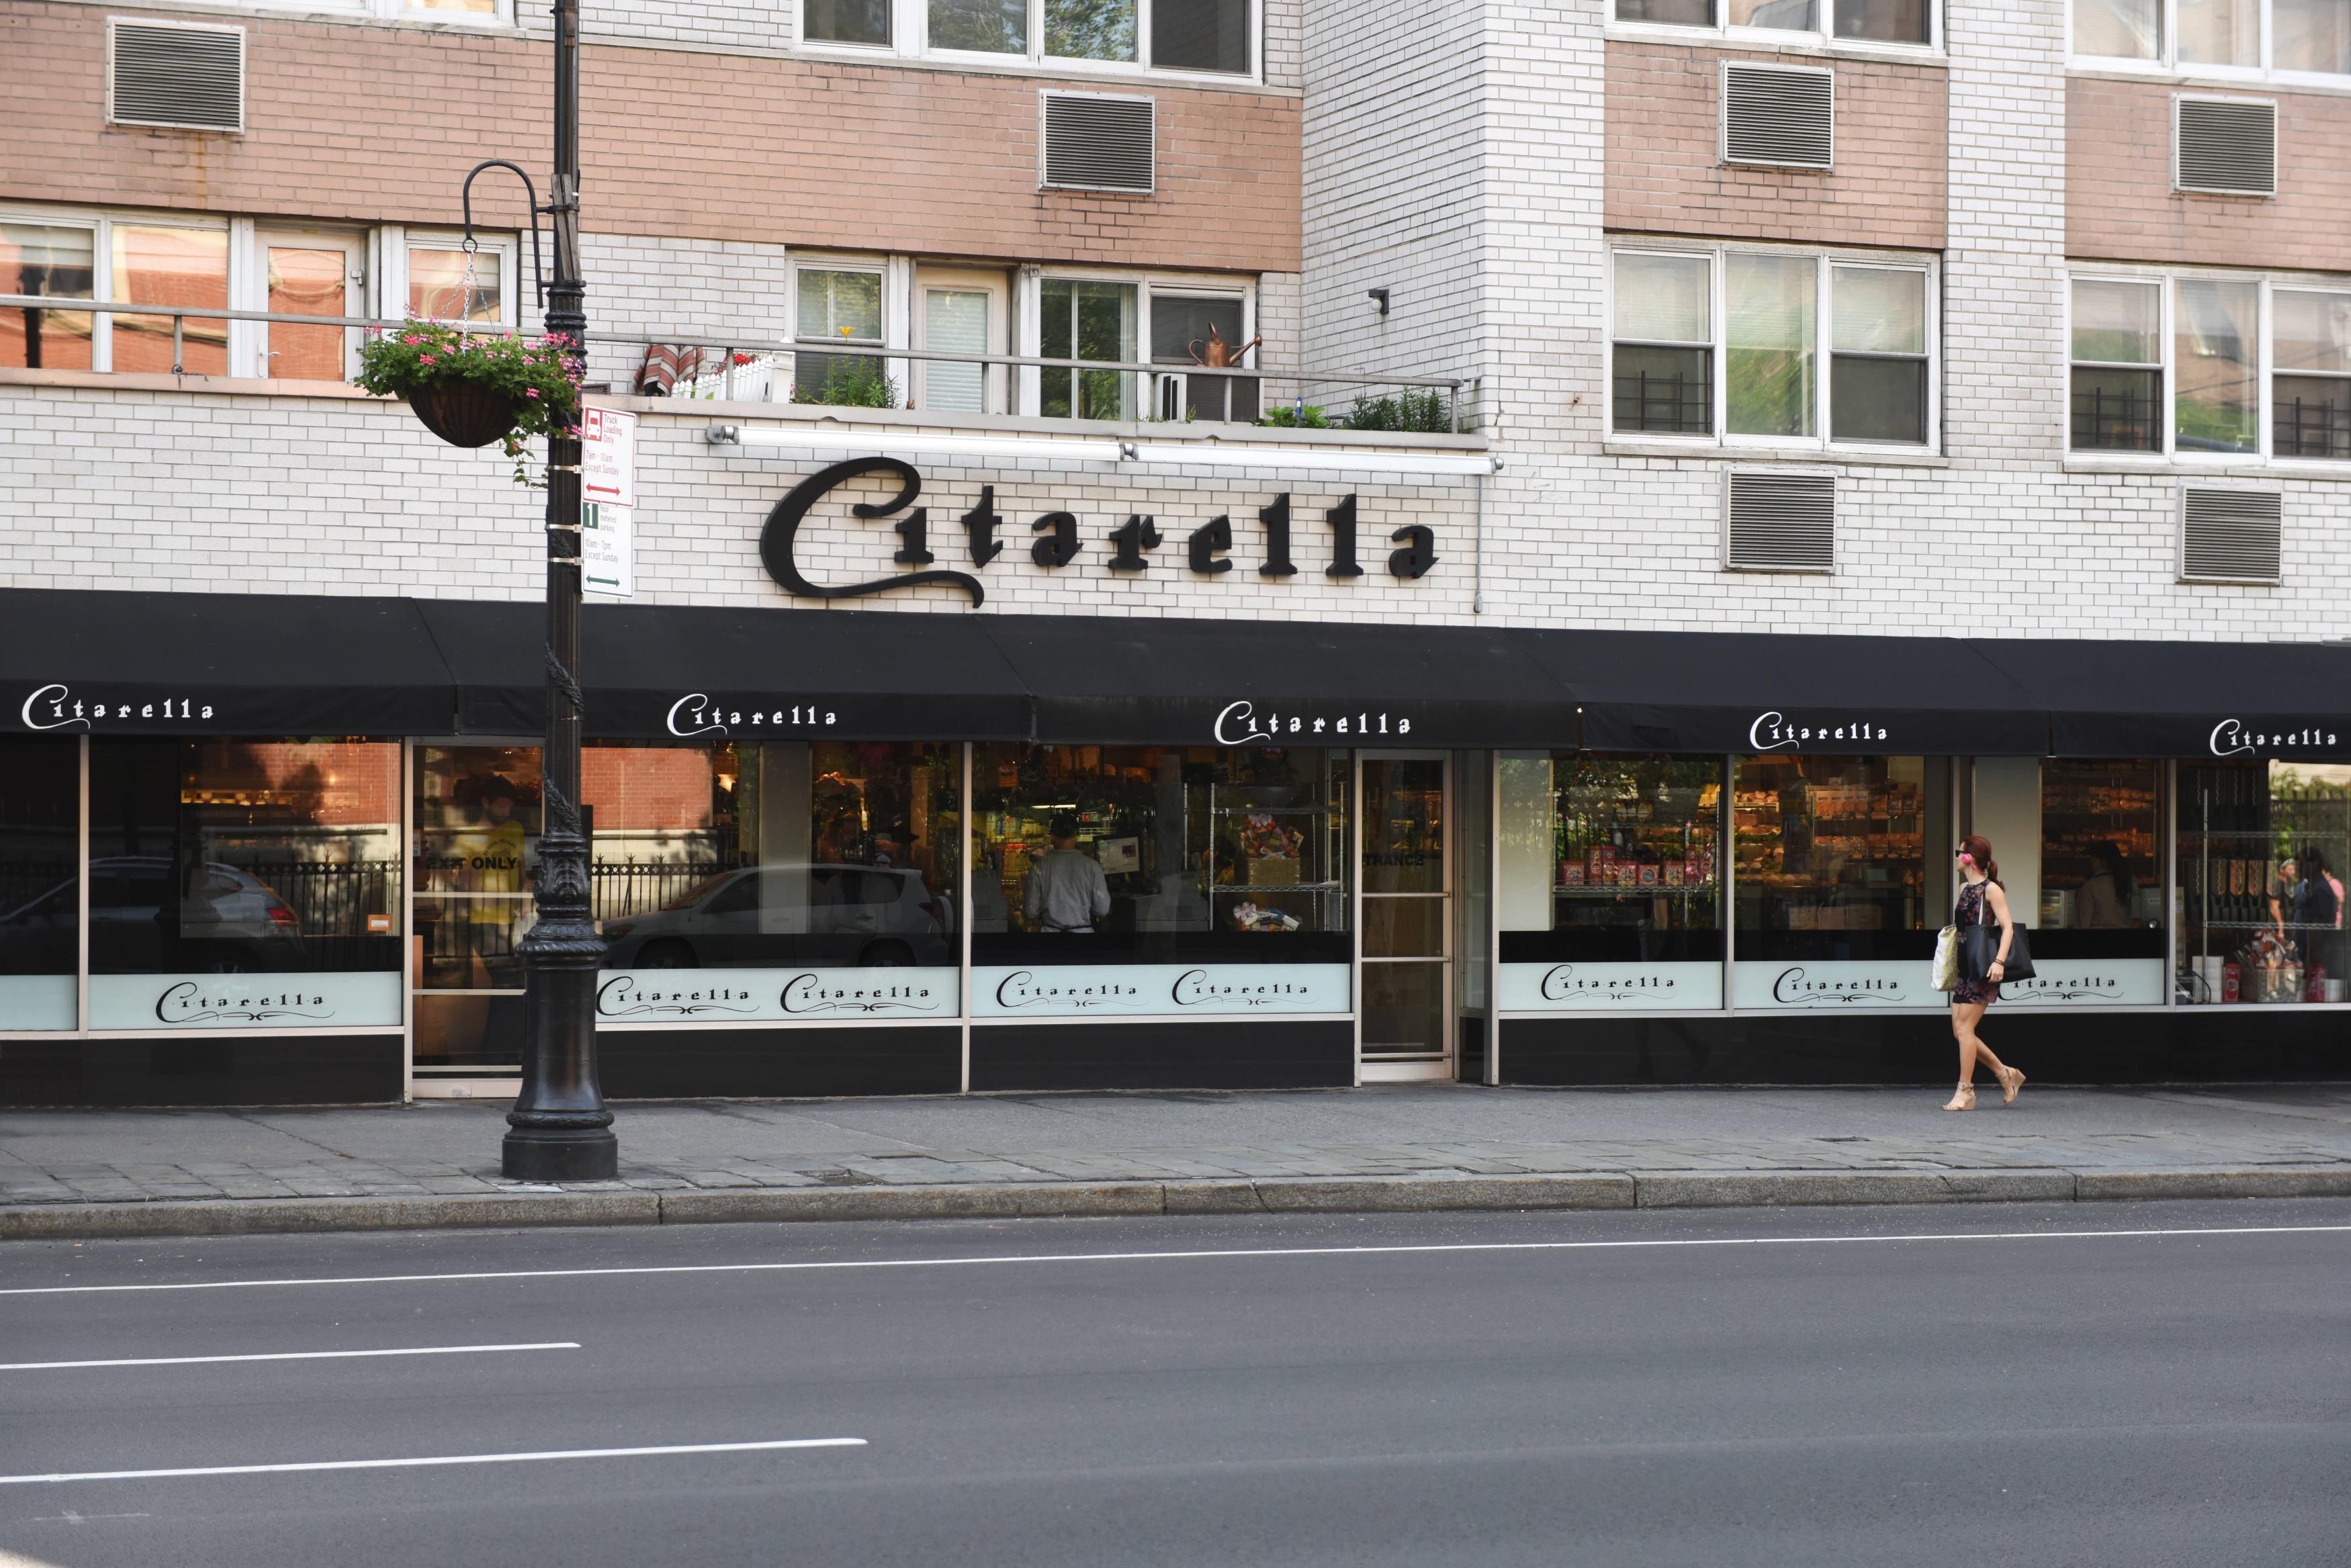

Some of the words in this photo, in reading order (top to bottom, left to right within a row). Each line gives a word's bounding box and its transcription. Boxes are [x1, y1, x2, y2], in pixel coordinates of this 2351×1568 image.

[604, 424, 622, 437] Loading
[605, 414, 617, 424] Truck
[586, 450, 596, 460] 7am
[601, 453, 613, 462] 10am
[604, 434, 614, 445] Only
[586, 462, 601, 473] Except
[603, 465, 619, 477] Sunday
[600, 515, 617, 523] metered
[600, 524, 615, 535] parking
[759, 457, 1440, 608] Citarella
[585, 539, 597, 548] 10am
[602, 541, 611, 551] 7pm
[585, 550, 601, 561] Except
[602, 553, 619, 564] Sunday
[22, 684, 214, 729] Citarella
[667, 694, 837, 736] Citarella
[1214, 701, 1411, 745] Citarella
[1749, 712, 1888, 749] Citarella
[2209, 719, 2337, 756] Citarella
[472, 857, 517, 870] ONLY
[1363, 854, 1425, 866] TRANCE
[596, 976, 749, 1015] Citarella
[781, 974, 930, 1013] Citarella
[996, 971, 1137, 1007] Citarella
[1171, 970, 1308, 1005] Citarella
[1541, 964, 1675, 1001] Citarella
[1773, 968, 1898, 1003] Citarella
[156, 982, 324, 1023] Citarella
